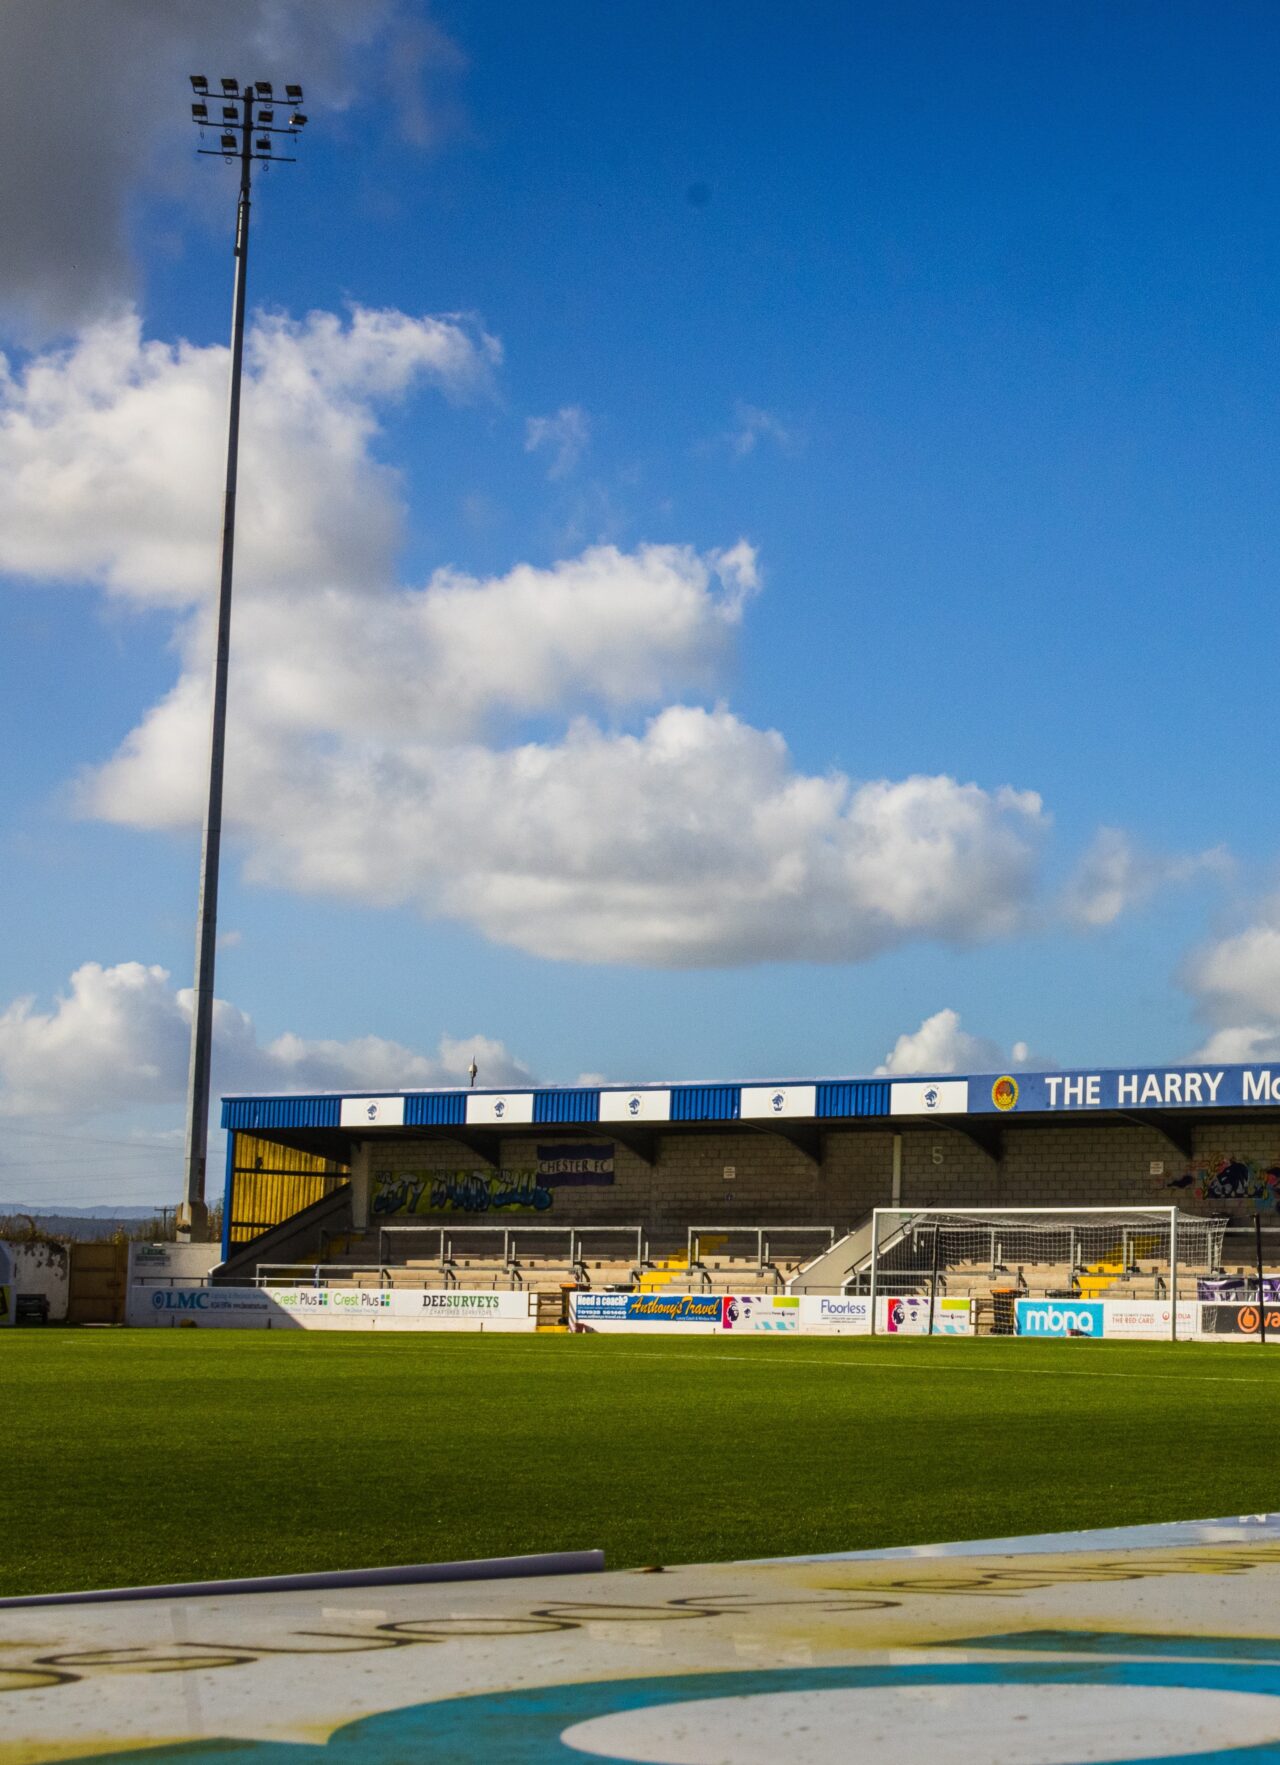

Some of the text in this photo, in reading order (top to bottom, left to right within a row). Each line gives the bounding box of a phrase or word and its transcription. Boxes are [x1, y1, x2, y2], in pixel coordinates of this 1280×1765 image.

[1044, 1075, 1101, 1106] THE
[1117, 1071, 1224, 1104] HARRY
[932, 1147, 943, 1165] 5
[539, 1159, 609, 1173] CHESTER FC
[165, 1291, 210, 1310] LMC
[273, 1292, 298, 1306] Crest
[300, 1292, 317, 1306] Plus
[333, 1292, 380, 1307] Crest Plus
[422, 1295, 500, 1308] DEESURVEYS
[681, 1296, 720, 1316] Travel
[821, 1299, 866, 1314] Floorless
[1027, 1305, 1093, 1331] mbna
